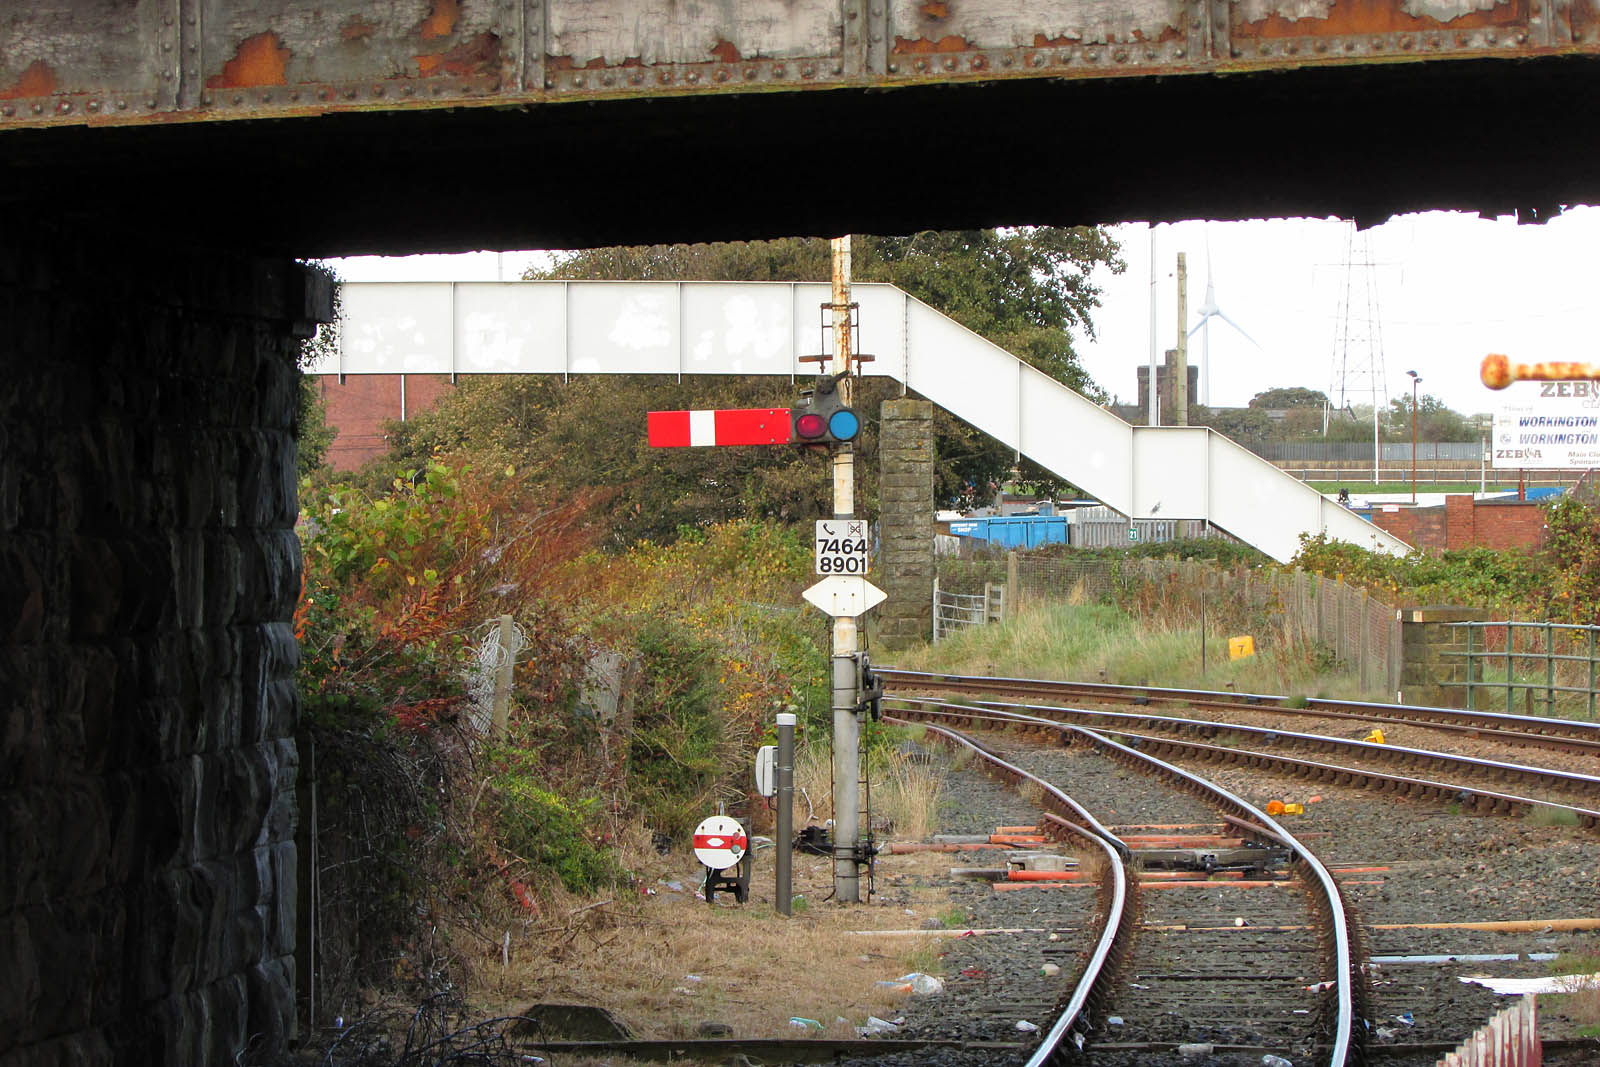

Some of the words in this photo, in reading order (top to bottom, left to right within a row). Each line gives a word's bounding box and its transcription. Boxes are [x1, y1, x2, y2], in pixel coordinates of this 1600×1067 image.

[1519, 416, 1598, 427] WORKINGTON
[1519, 434, 1598, 444] WORKINGTON
[1129, 530, 1137, 539] 21
[818, 539, 867, 554] 7464
[820, 557, 866, 572] 8901
[1237, 645, 1245, 655] 7
